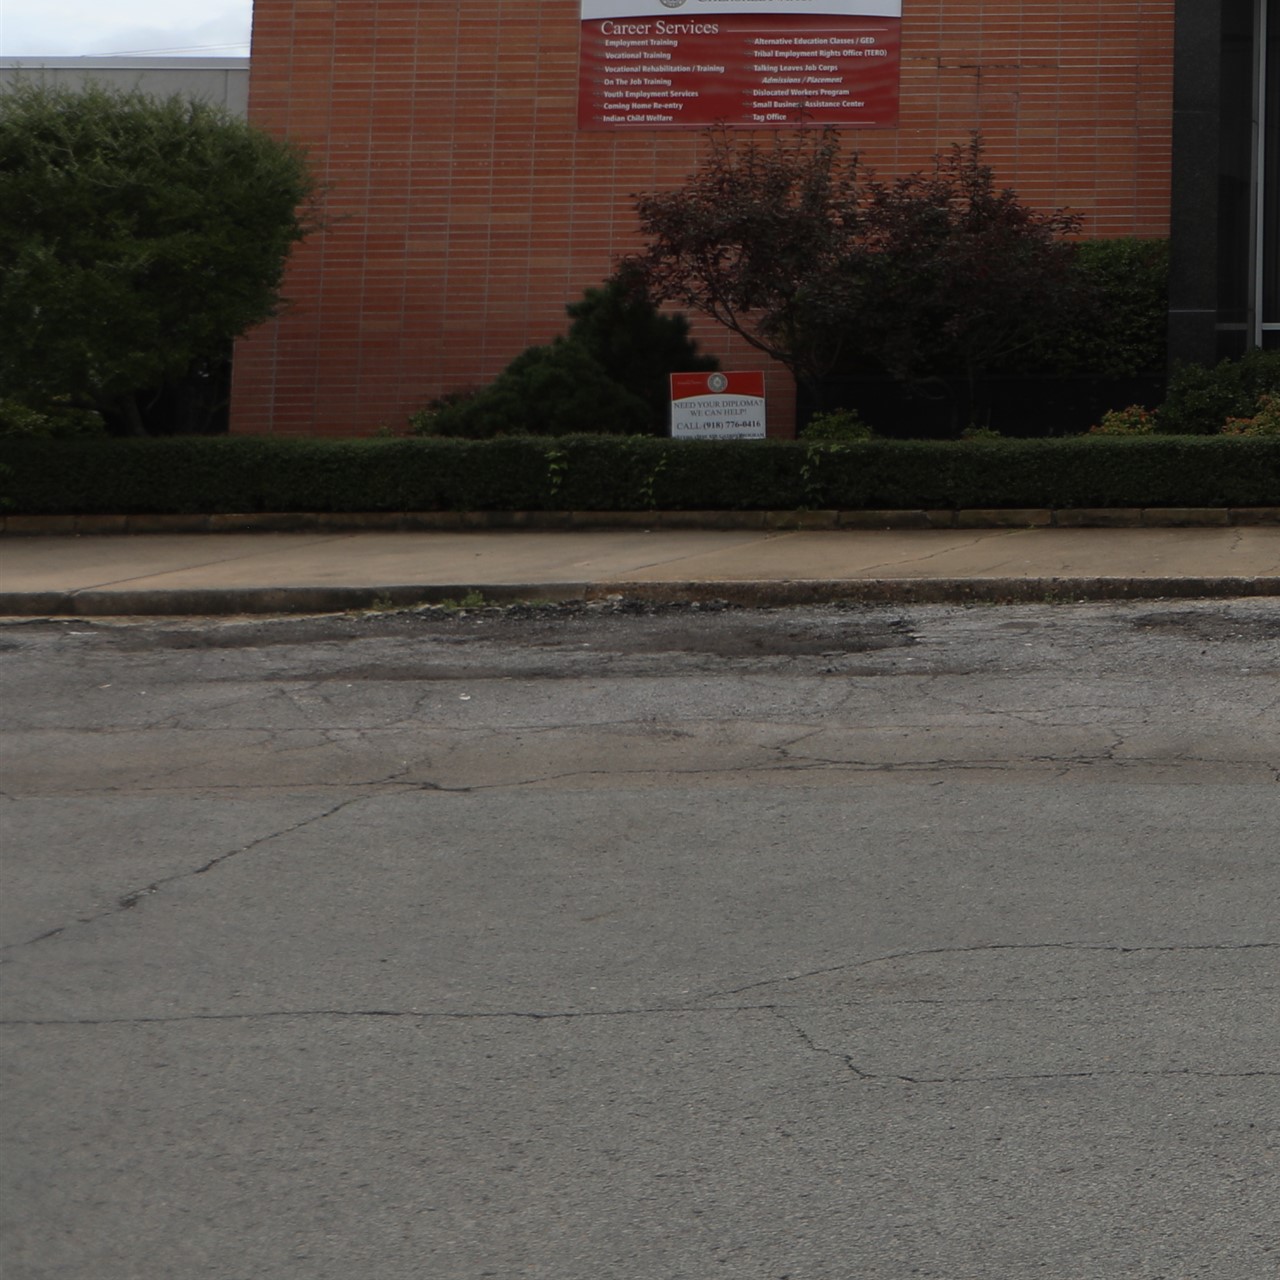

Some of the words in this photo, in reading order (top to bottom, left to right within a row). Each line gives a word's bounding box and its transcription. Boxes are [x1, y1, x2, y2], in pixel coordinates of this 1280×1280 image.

[601, 21, 651, 35] Career
[656, 20, 719, 34] Services
[625, 91, 668, 99] Employment
[821, 89, 849, 97] Program
